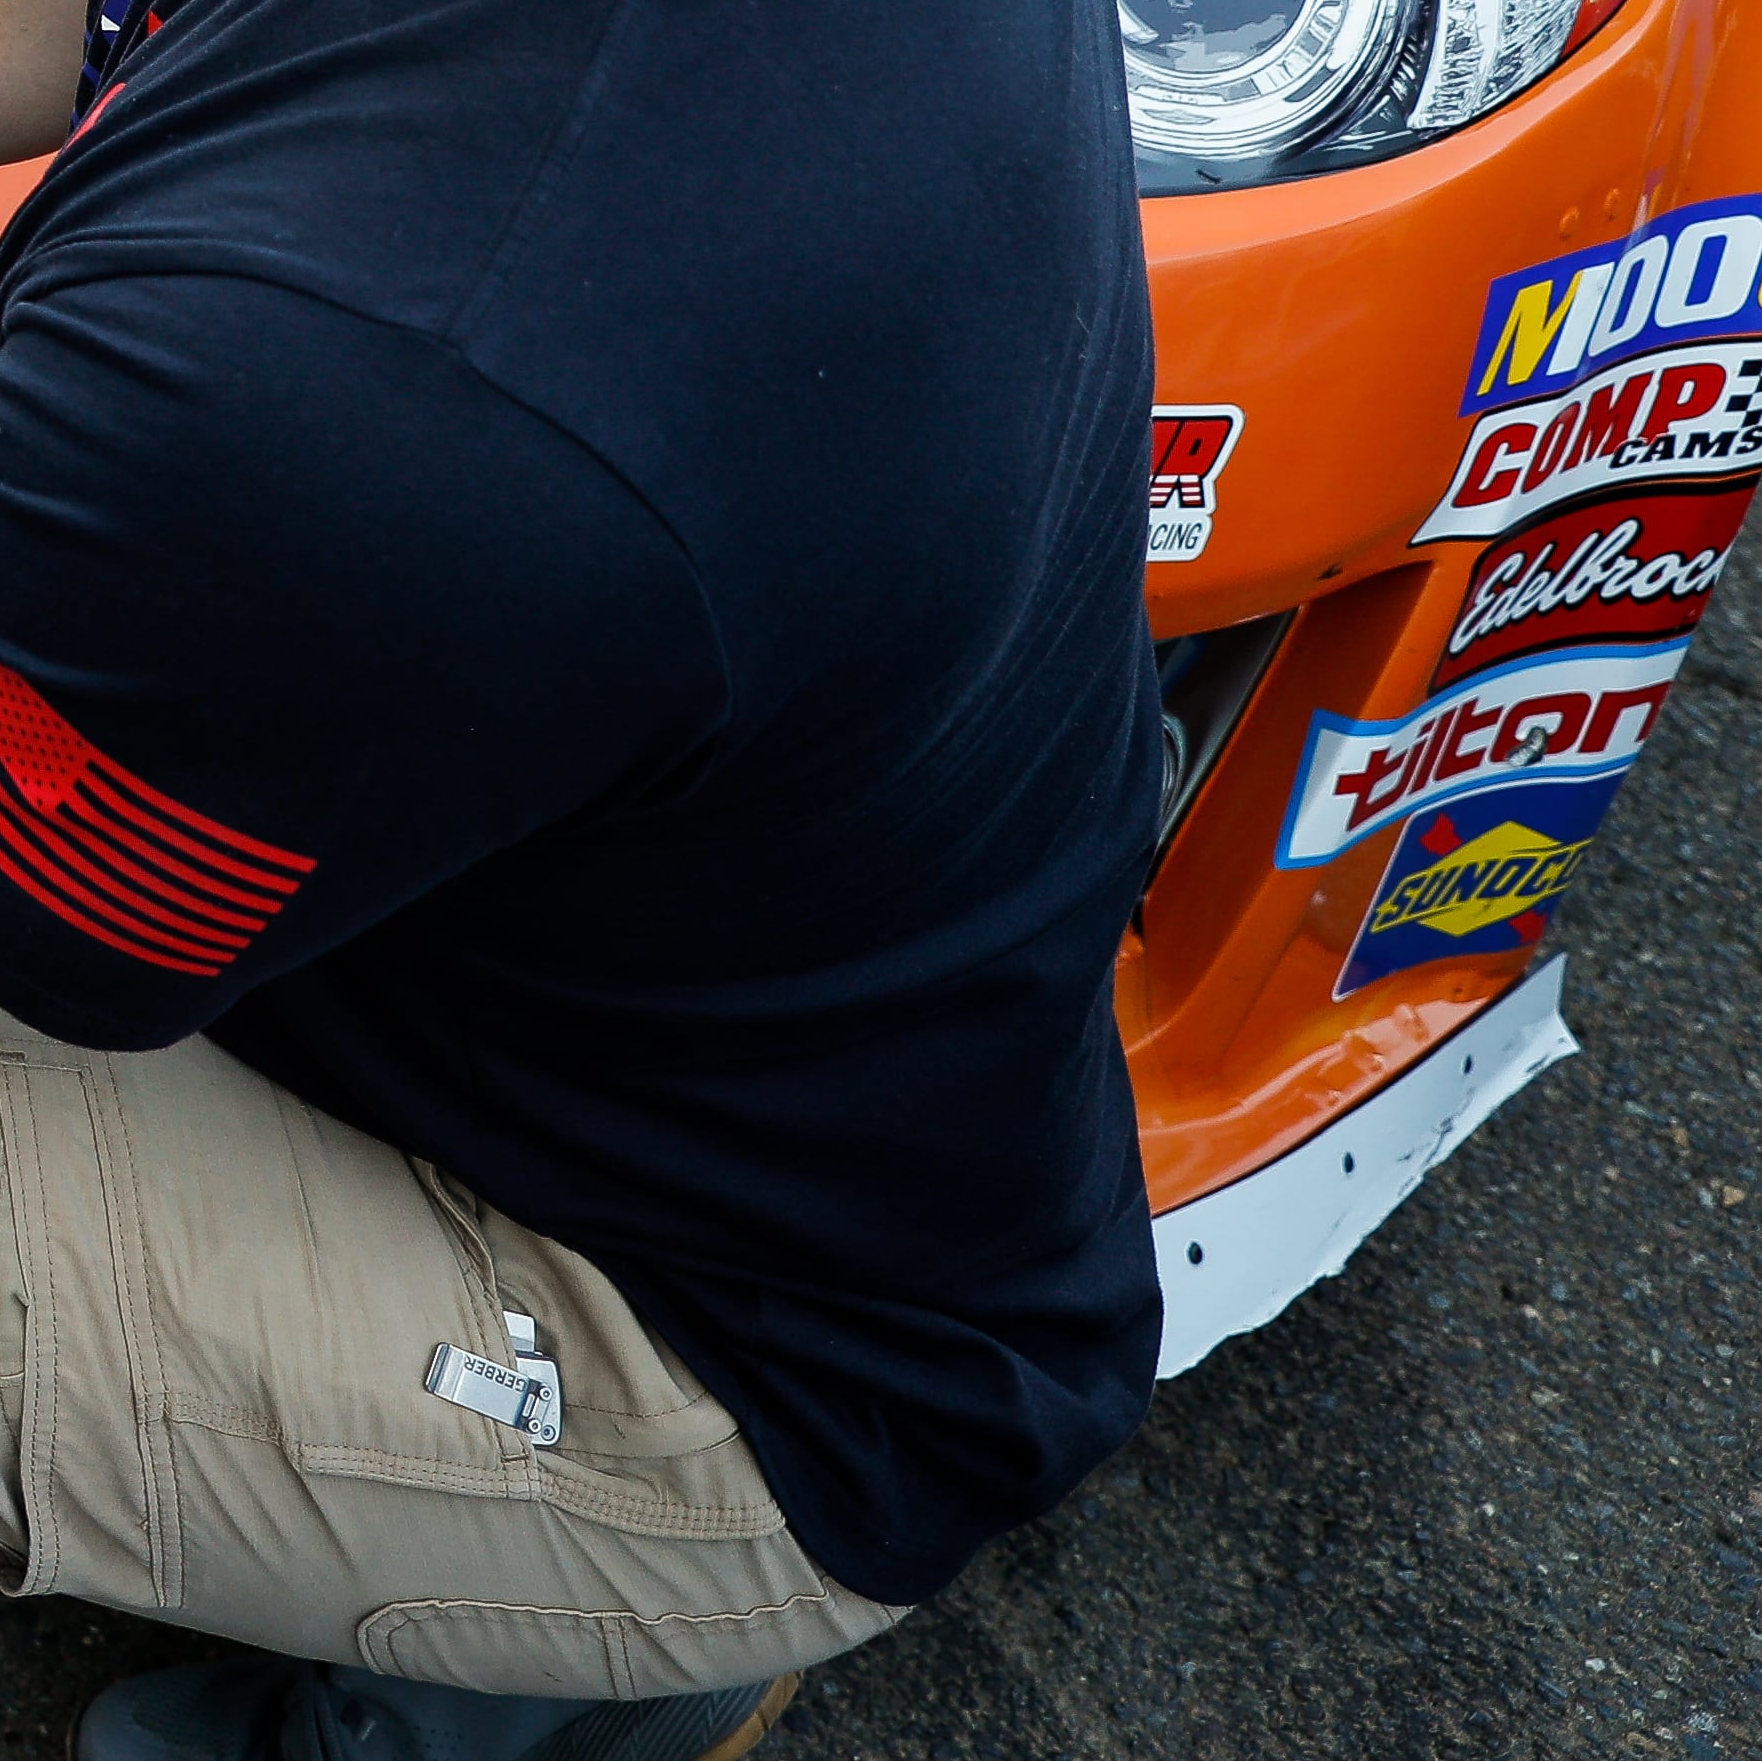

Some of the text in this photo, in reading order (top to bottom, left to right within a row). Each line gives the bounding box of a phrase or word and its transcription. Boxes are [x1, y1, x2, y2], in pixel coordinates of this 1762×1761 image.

[1476, 214, 1762, 397] MOO
[1451, 363, 1726, 508] COMP
[1608, 425, 1762, 469] CAMS
[1148, 522, 1203, 551] CING
[1334, 681, 1674, 832] tilton
[464, 1356, 528, 1393] GERBER
